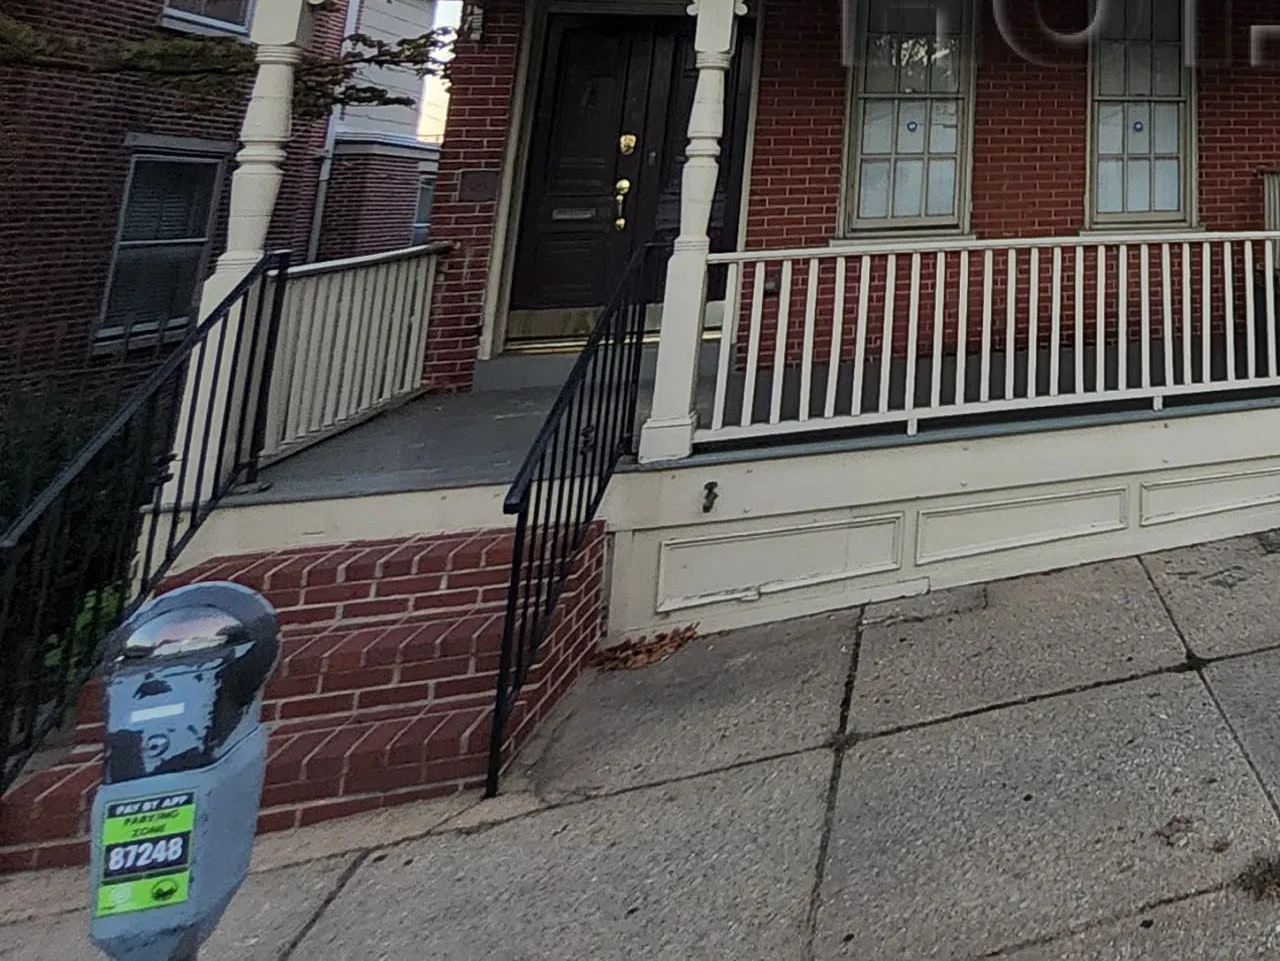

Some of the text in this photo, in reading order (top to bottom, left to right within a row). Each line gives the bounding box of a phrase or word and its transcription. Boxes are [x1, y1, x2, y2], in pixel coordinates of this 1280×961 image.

[115, 795, 189, 815] PAY BY APP
[108, 837, 184, 871] 87248
